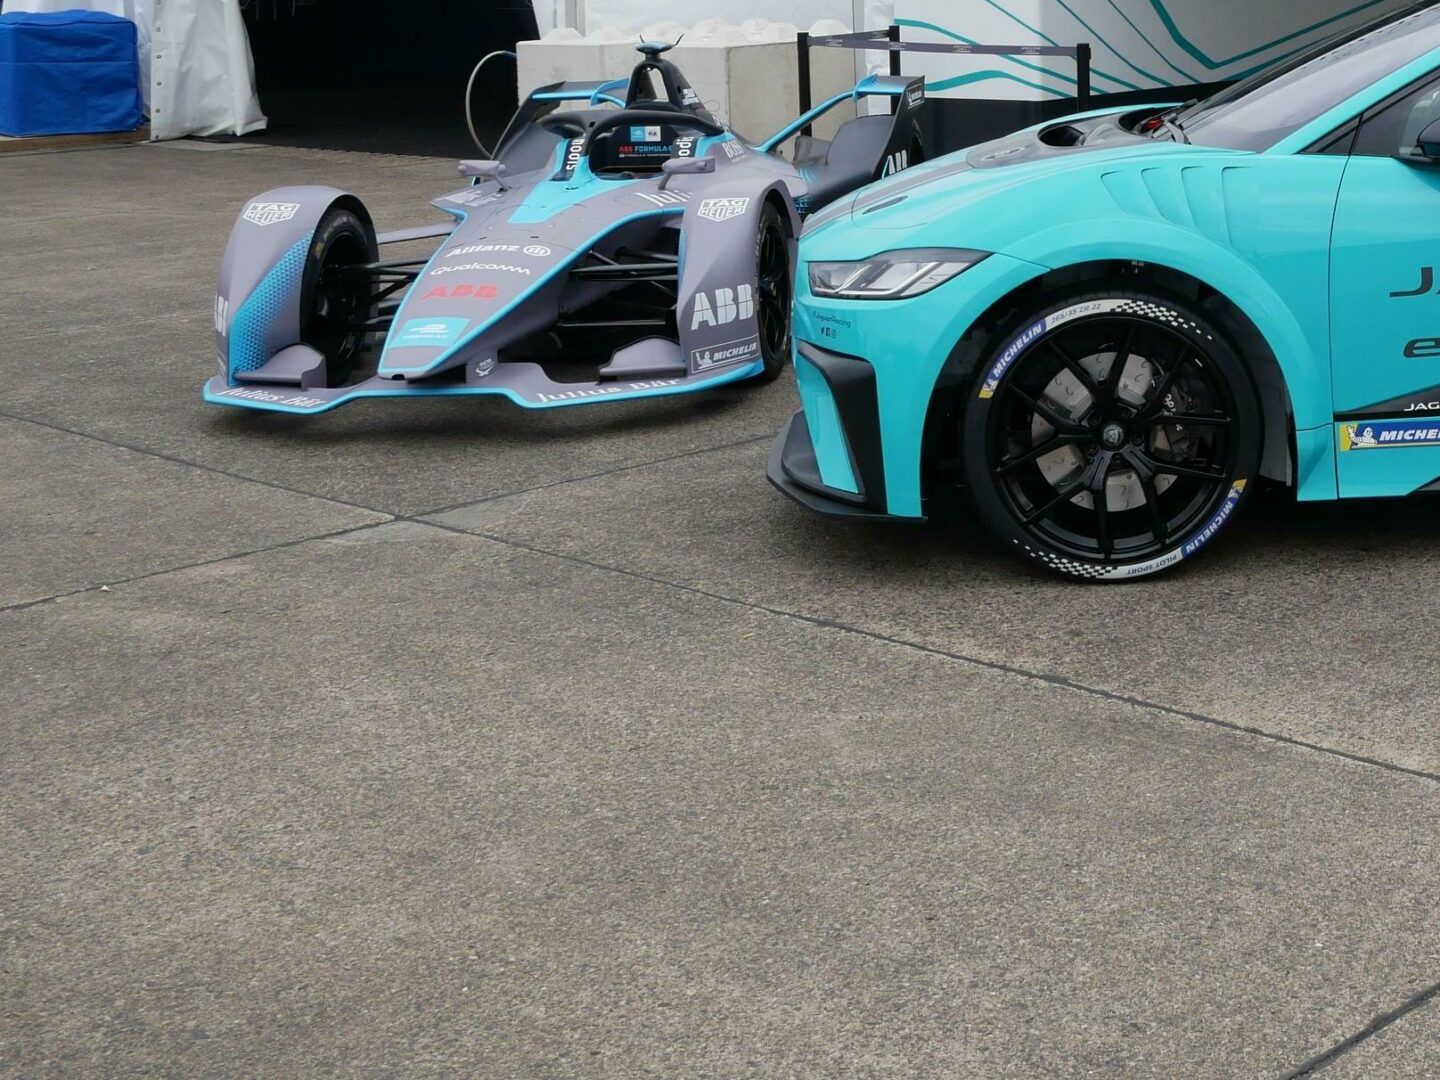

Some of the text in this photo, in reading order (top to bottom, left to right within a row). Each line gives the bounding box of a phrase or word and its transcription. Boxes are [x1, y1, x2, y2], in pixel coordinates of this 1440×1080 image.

[255, 203, 293, 211] TAG
[701, 206, 744, 219] HEUER
[246, 211, 291, 223] HEUER
[445, 244, 520, 258] Allianz
[420, 284, 499, 300] ABB
[690, 283, 754, 331] ABB
[713, 341, 758, 361] MICHELIN
[992, 323, 1042, 378] MICHELIN
[536, 387, 621, 403] Julius
[1185, 500, 1234, 554] MICHELIN
